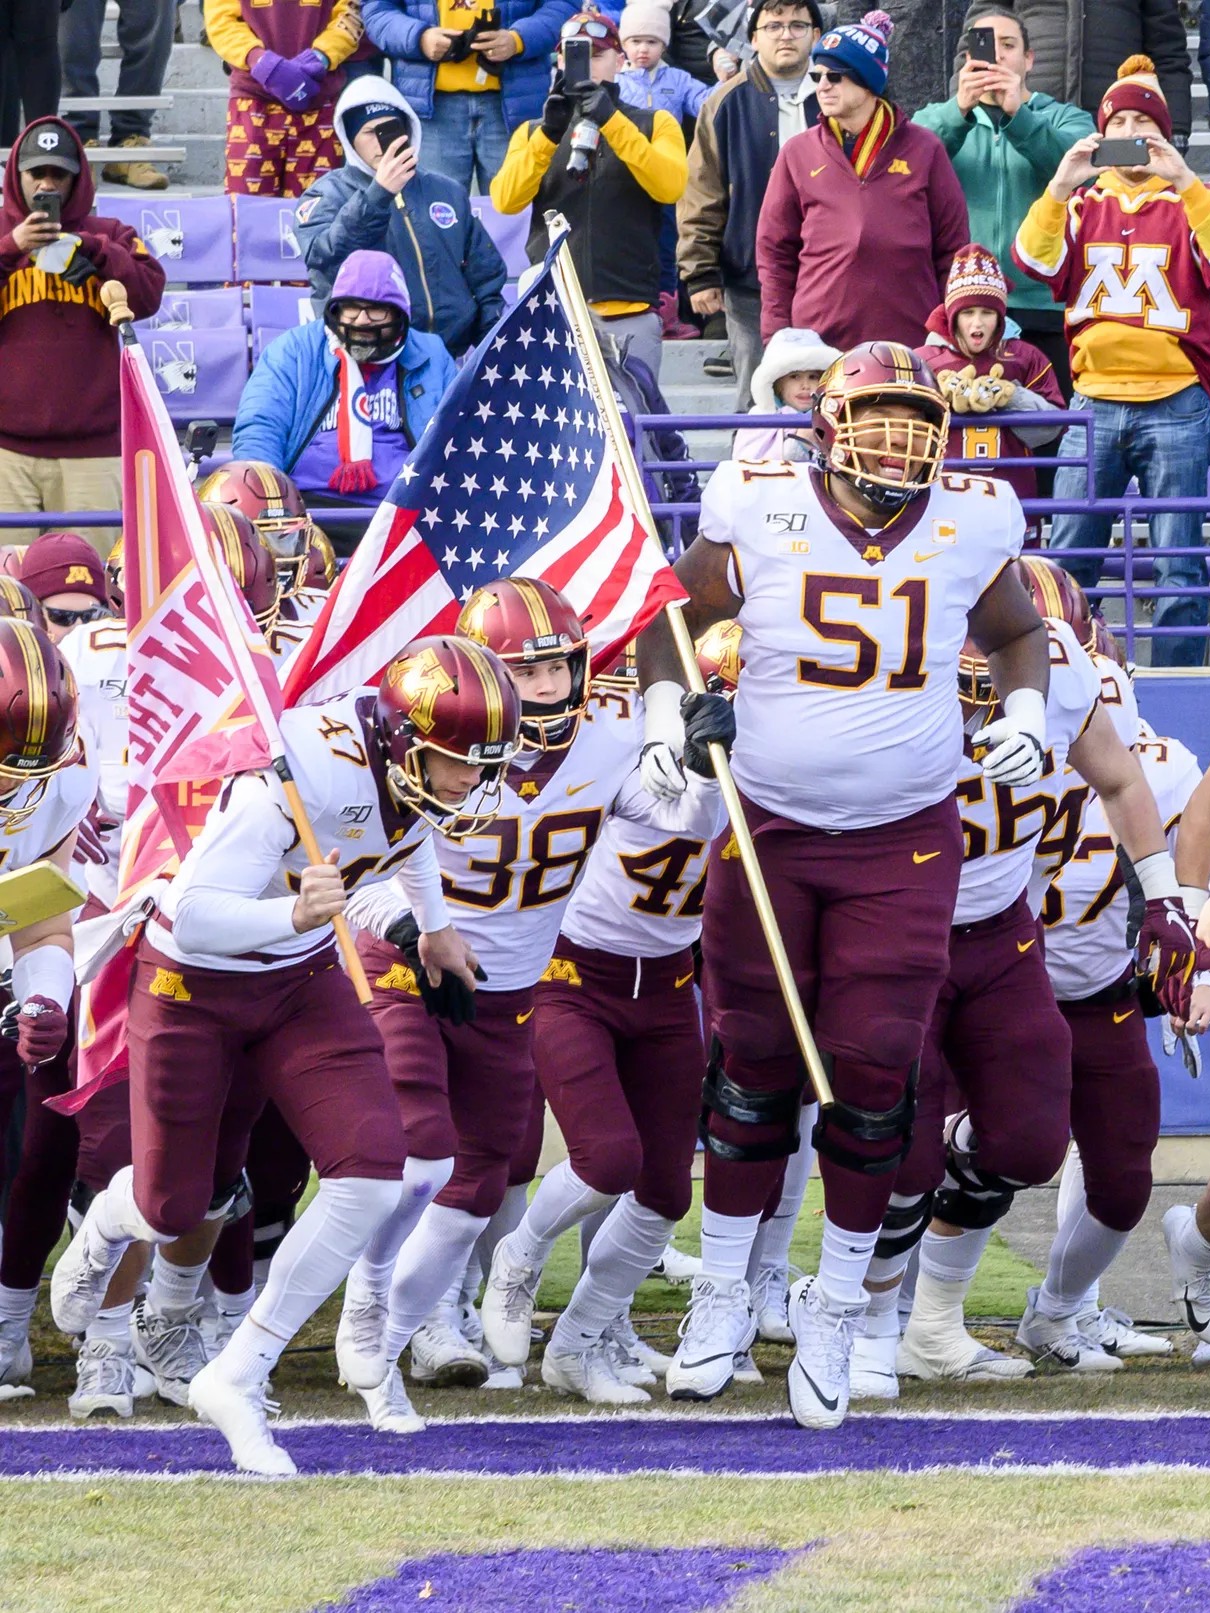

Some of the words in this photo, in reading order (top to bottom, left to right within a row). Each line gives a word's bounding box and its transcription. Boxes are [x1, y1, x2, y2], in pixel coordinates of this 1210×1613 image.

[1064, 242, 1191, 333] M
[797, 571, 930, 692] 51
[439, 805, 605, 913] 38
